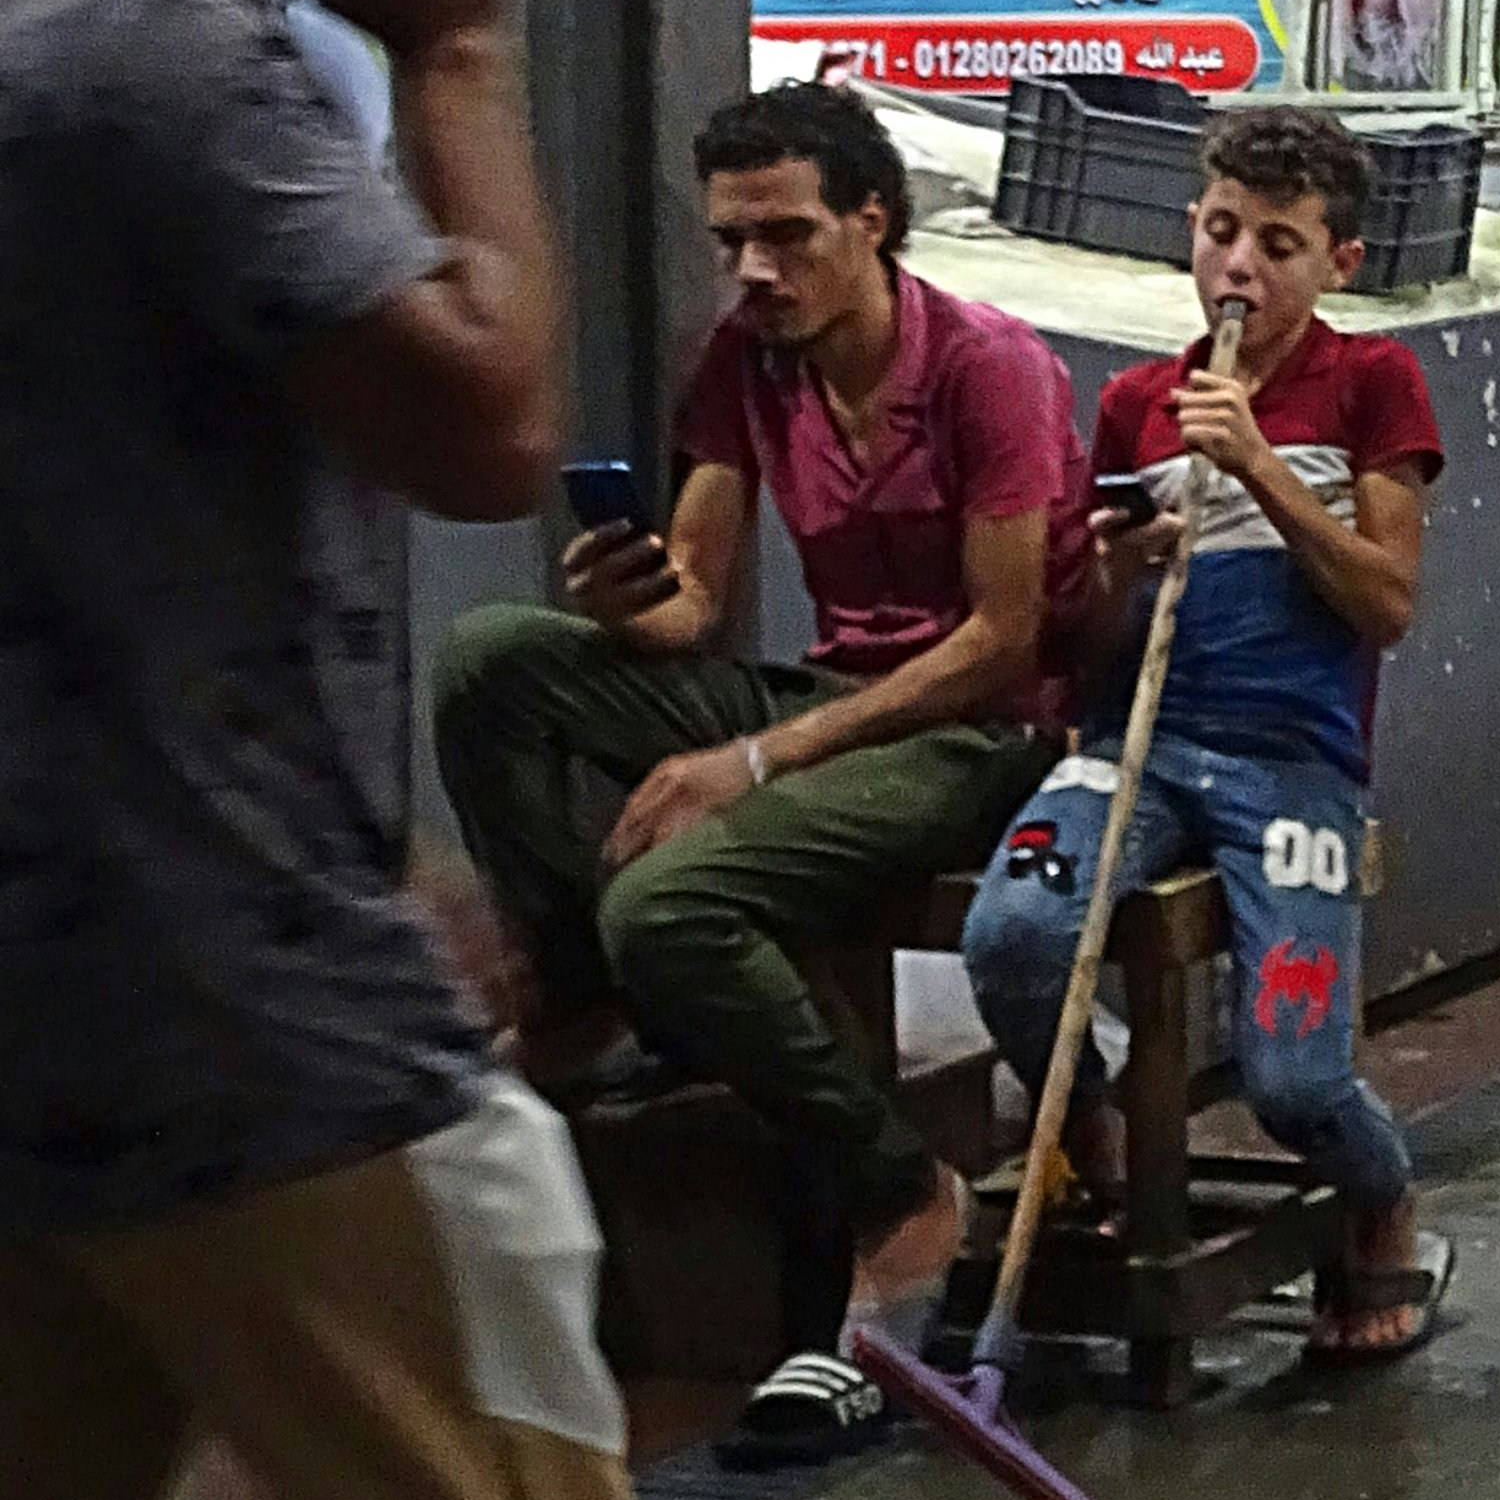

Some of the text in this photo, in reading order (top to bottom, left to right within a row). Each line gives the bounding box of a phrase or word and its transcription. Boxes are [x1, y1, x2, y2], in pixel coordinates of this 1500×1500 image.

[914, 39, 1125, 78] 01280262089
[1136, 40, 1225, 75] عبد الله
